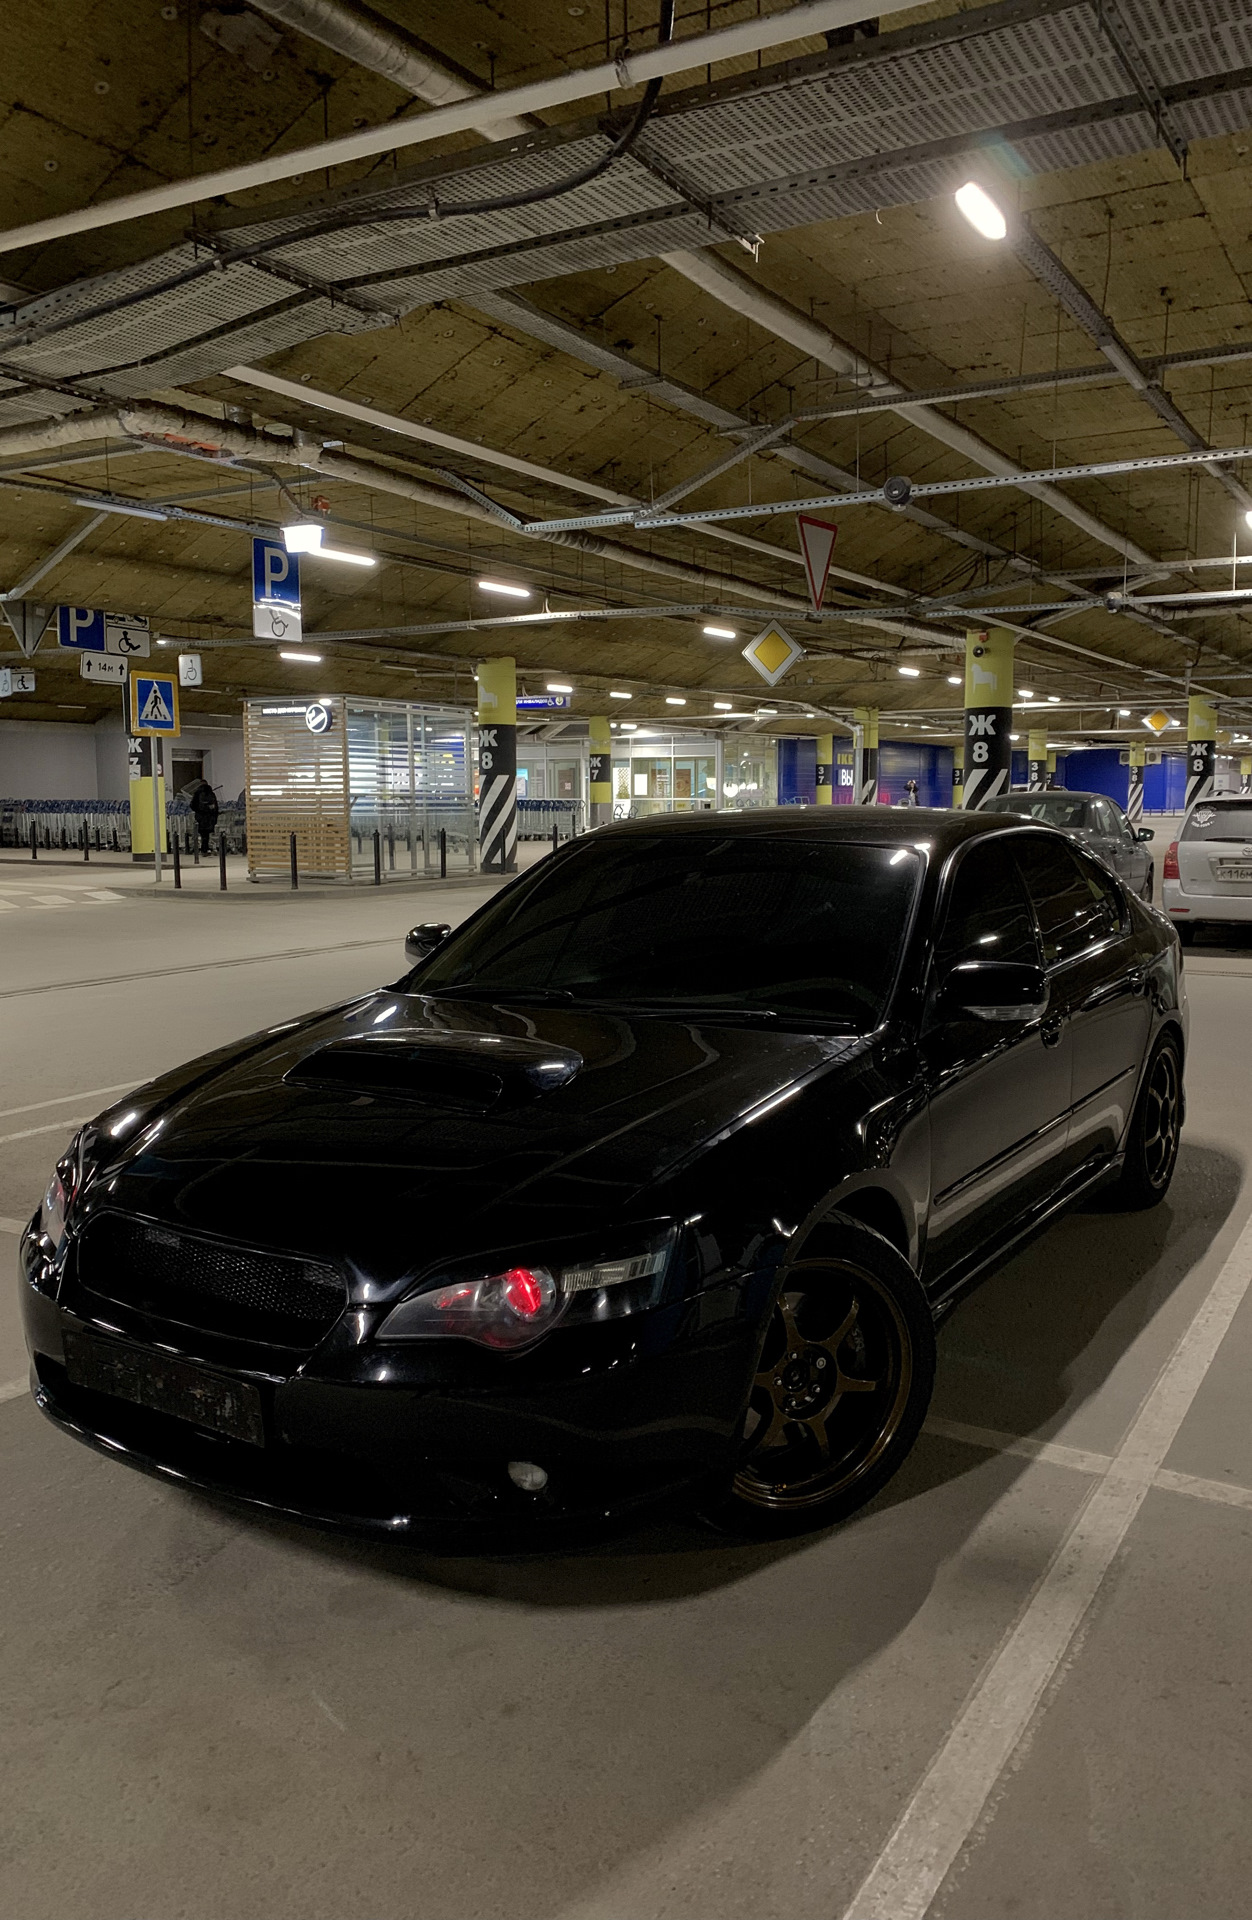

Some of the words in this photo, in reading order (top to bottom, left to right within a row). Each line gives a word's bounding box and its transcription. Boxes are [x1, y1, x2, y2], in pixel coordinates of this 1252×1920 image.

[264, 547, 289, 598] P
[69, 607, 95, 642] P
[968, 714, 996, 736] Ж
[127, 737, 143, 753] Ж
[479, 729, 498, 747] Ж
[972, 741, 989, 763] 8
[1190, 743, 1209, 756] Ж
[481, 752, 493, 770] 8
[590, 757, 602, 768] Ж
[837, 753, 853, 765] IKE
[1193, 758, 1204, 772] 8
[591, 769, 600, 781] 7
[818, 776, 825, 784] 7
[1031, 772, 1039, 781] 8
